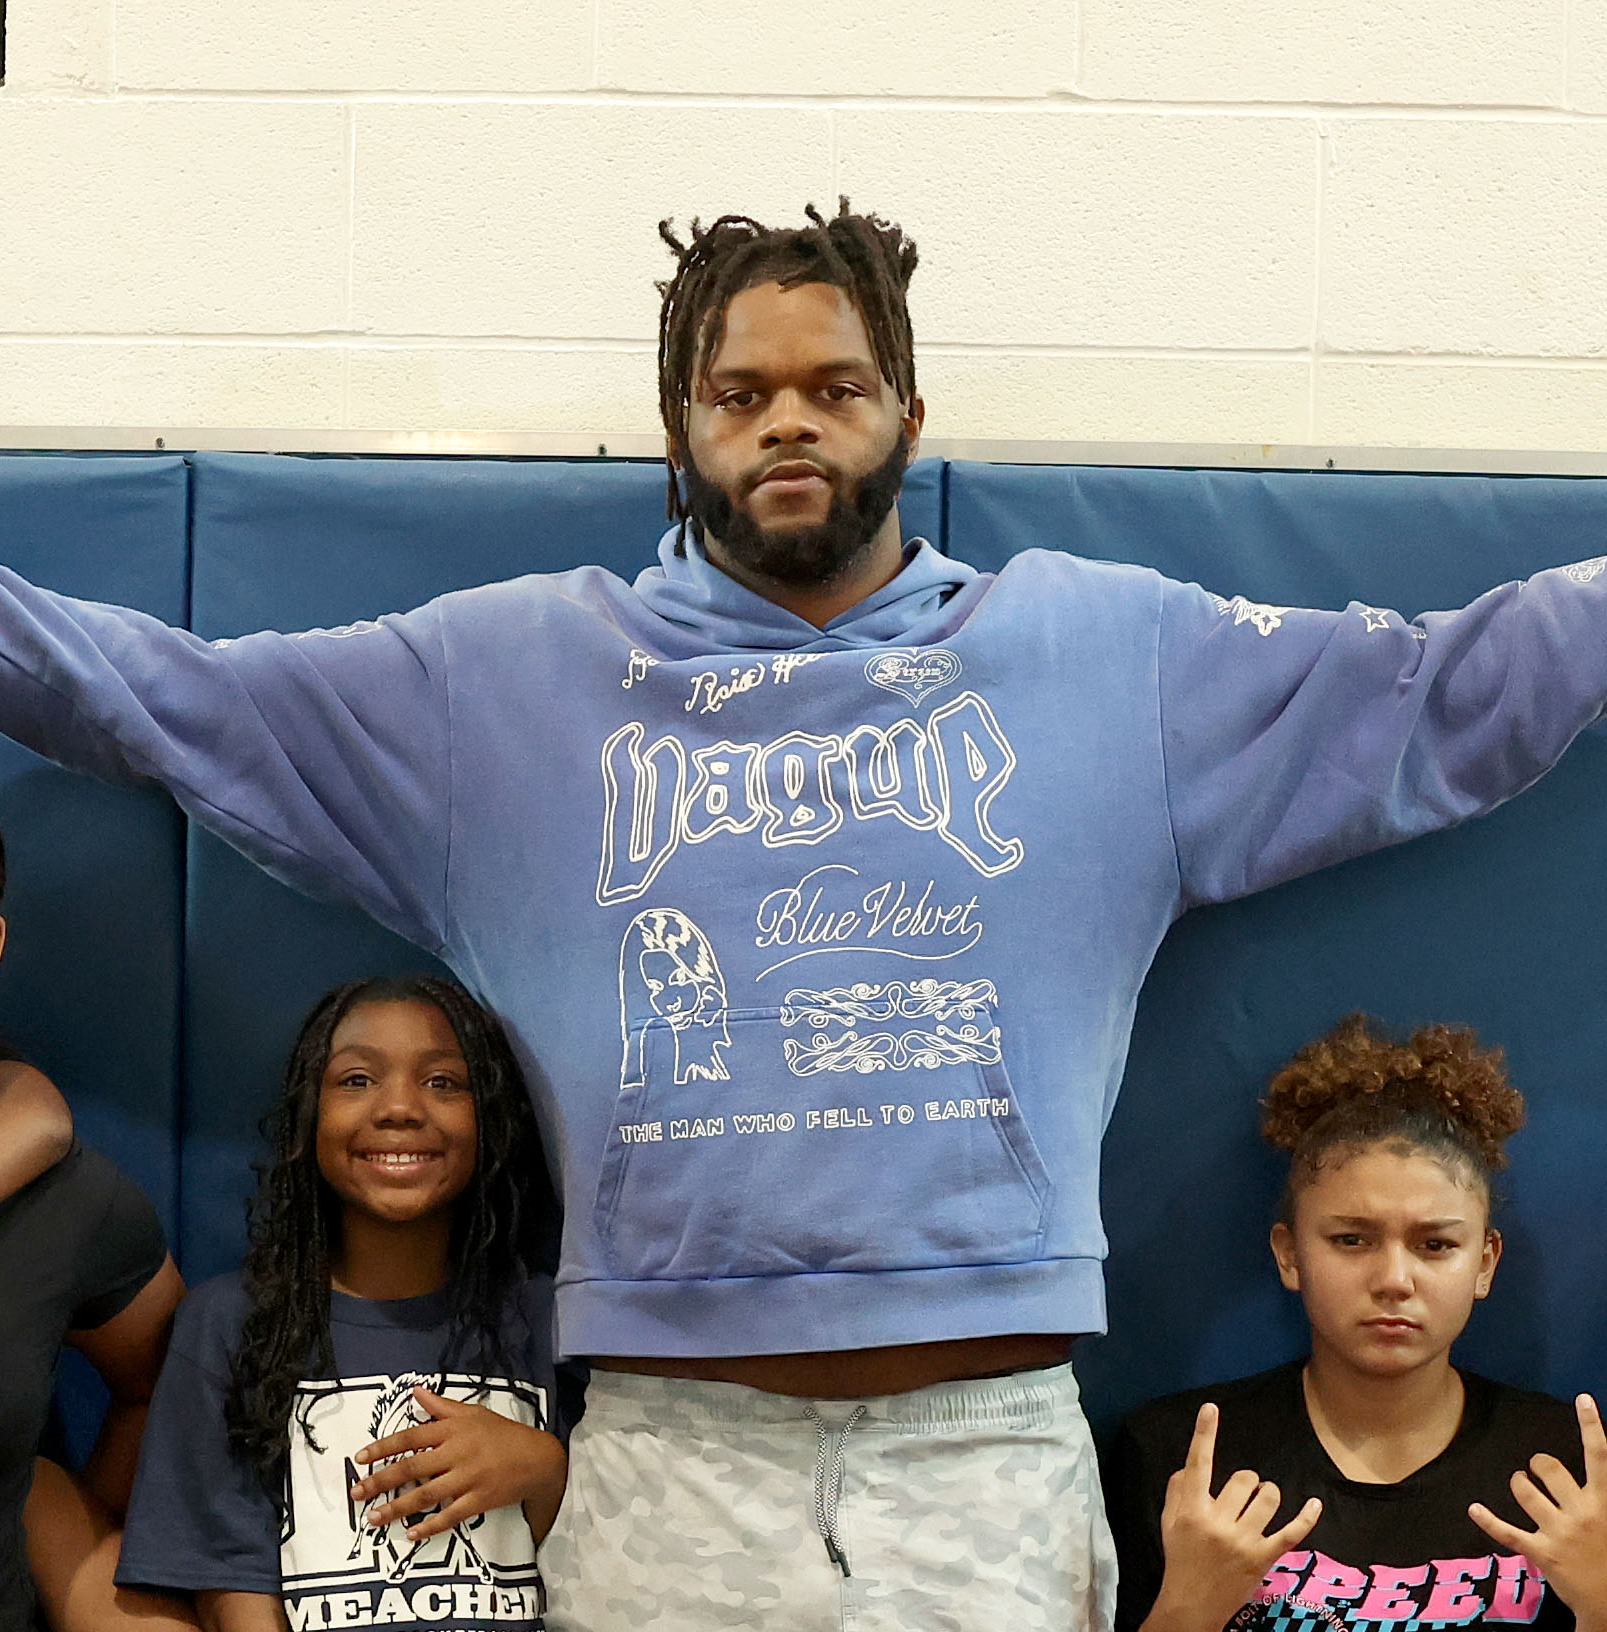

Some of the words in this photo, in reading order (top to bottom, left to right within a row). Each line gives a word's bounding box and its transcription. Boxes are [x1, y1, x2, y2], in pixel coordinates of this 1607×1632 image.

[755, 864, 860, 948] Blue
[857, 879, 984, 947] Velvet
[619, 1121, 664, 1144] THE
[669, 1116, 725, 1140] MAN
[733, 1111, 796, 1134] WHO
[806, 1106, 873, 1130] FELL
[880, 1103, 915, 1125] TO
[924, 1097, 1010, 1122] EARTH
[1235, 1600, 1261, 1627] BOLT
[1262, 1593, 1281, 1607] OF
[1252, 1549, 1547, 1625] SPEED
